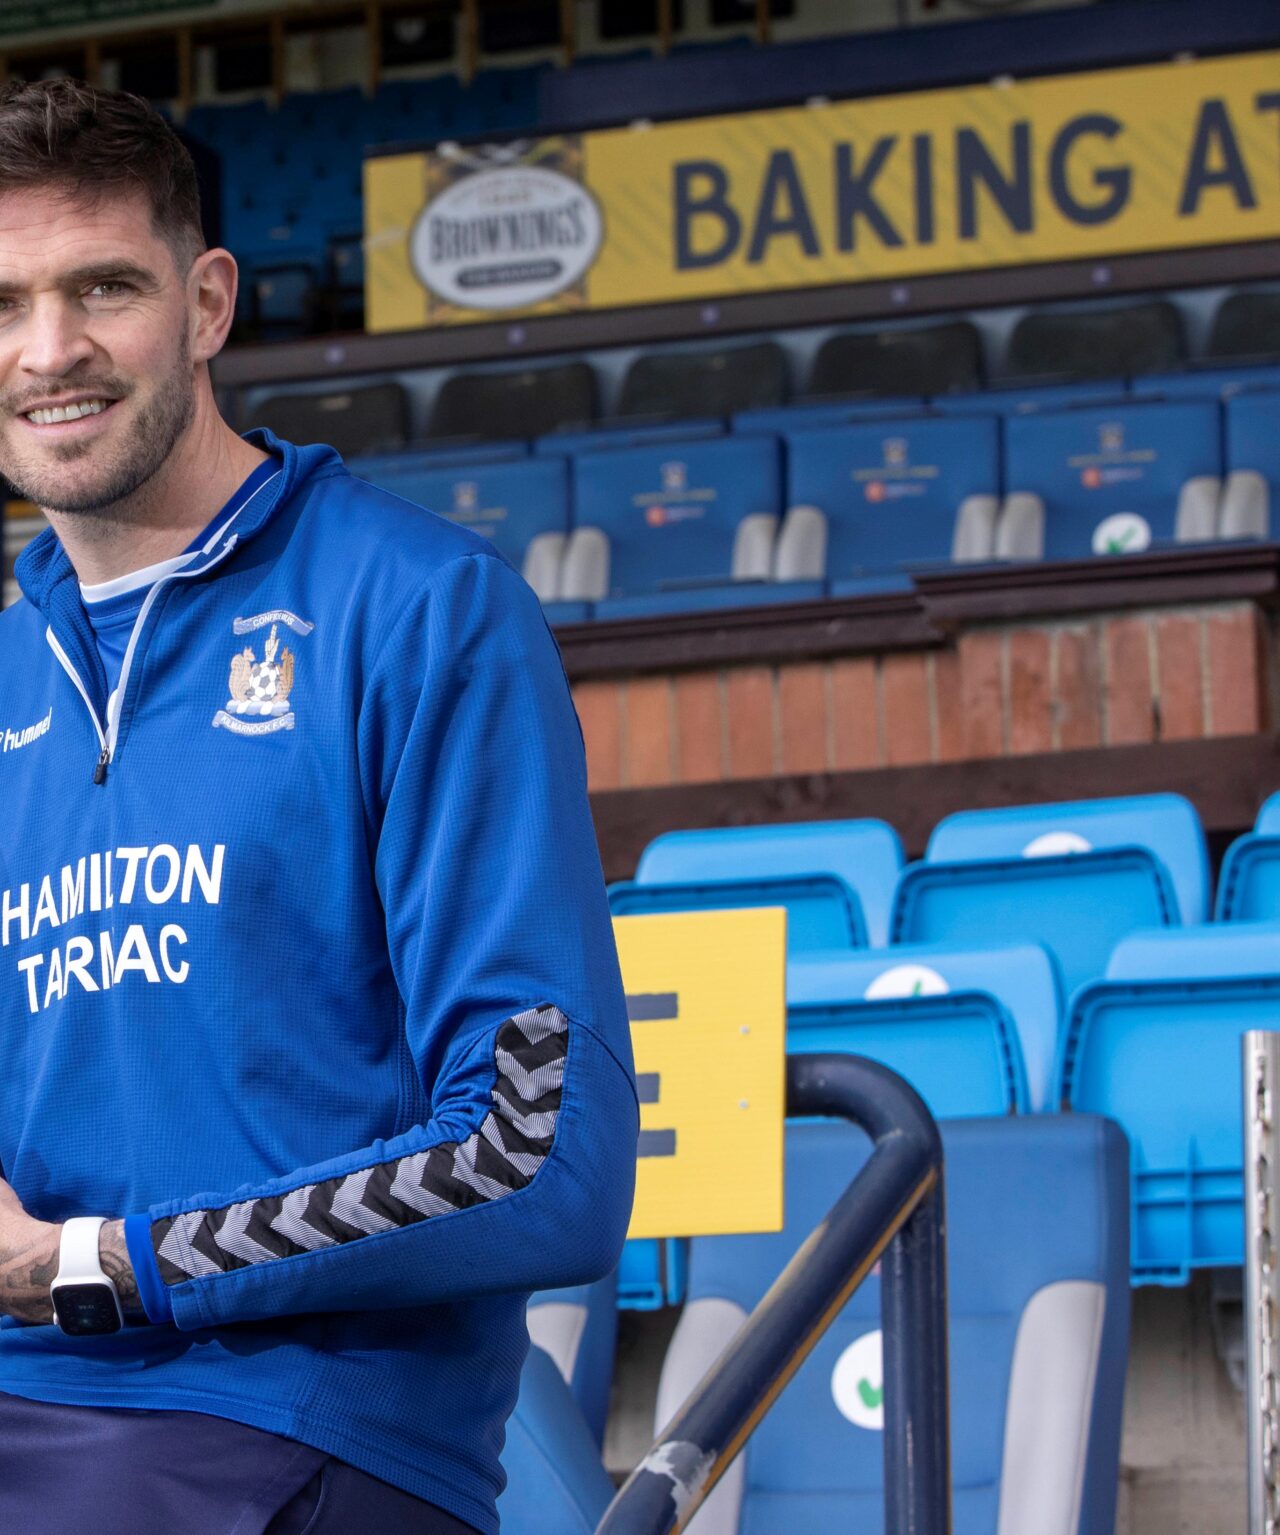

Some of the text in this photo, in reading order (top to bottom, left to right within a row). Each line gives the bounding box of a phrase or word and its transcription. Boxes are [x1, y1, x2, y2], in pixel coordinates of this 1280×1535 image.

[672, 113, 1132, 271] BAKING
[3, 706, 53, 753] hummel
[2, 843, 226, 947] HAMILTON
[17, 923, 190, 1014] TARMAC
